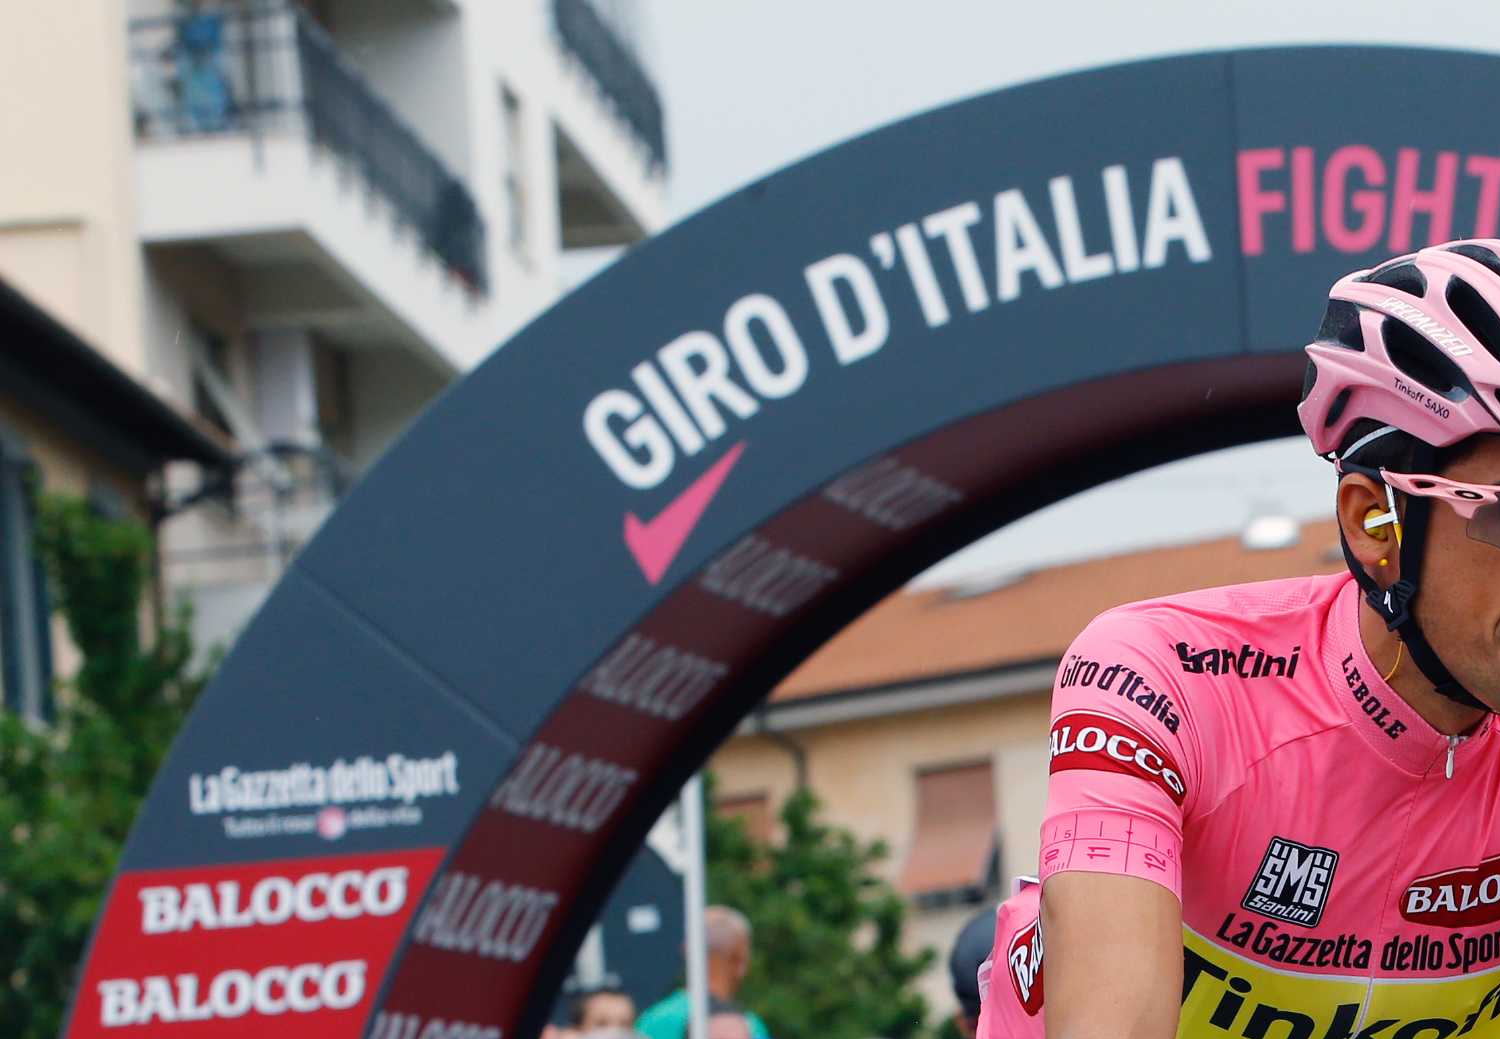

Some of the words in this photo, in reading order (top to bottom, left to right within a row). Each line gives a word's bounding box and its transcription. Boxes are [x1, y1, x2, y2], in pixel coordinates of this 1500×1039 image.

[583, 292, 808, 490] GIRO
[805, 157, 1211, 366] D'ITALIA
[1376, 296, 1473, 356] SPECIALIZED
[1392, 377, 1424, 402] Tinkoff
[1424, 399, 1450, 420] SAXO
[1171, 641, 1302, 680] Santini
[1059, 653, 1101, 690] Giro
[1097, 663, 1182, 737] d'Italia
[1341, 652, 1407, 740] LEBOLE
[190, 772, 221, 814] La
[388, 749, 459, 804] Sport
[1050, 726, 1185, 797] ALOCCO
[139, 866, 409, 935] BALOCCO
[1254, 842, 1333, 908] SMS
[415, 871, 560, 963] ALOCCO
[1217, 912, 1254, 949] La
[1251, 921, 1373, 970] Gazzetta
[1380, 934, 1446, 971] dello
[1248, 894, 1317, 923] Santini
[98, 961, 367, 1028] BALOCCO
